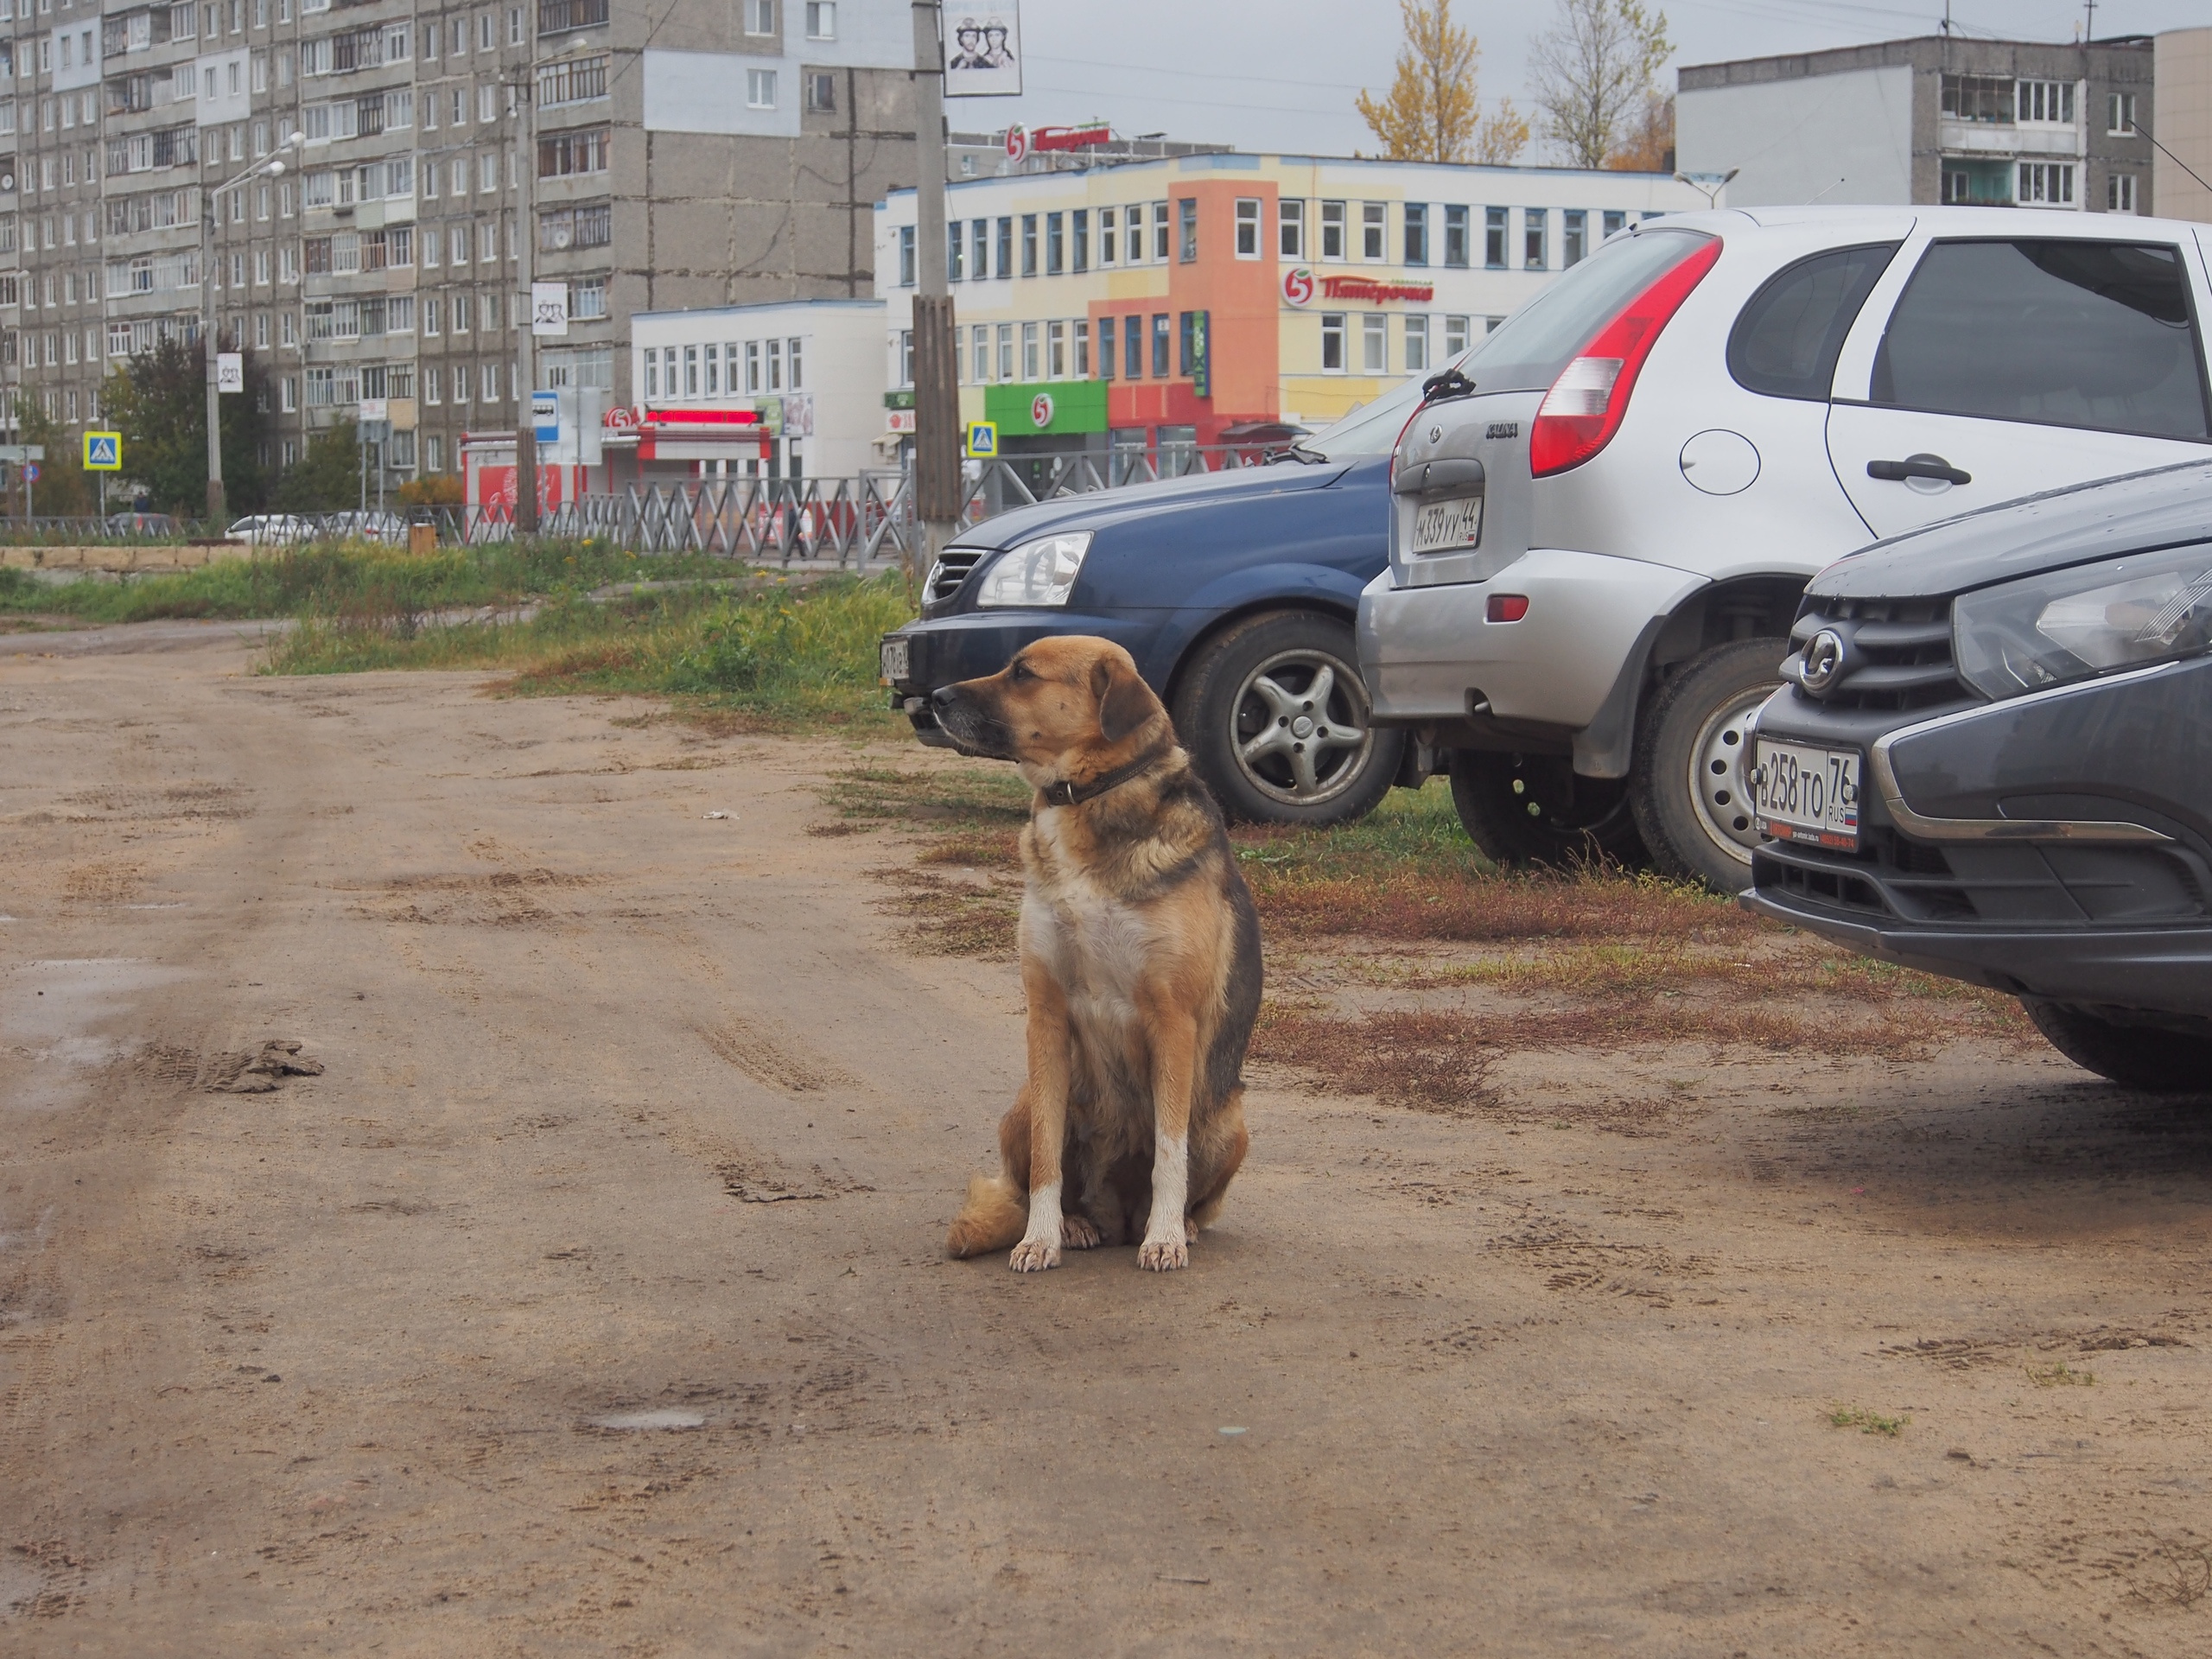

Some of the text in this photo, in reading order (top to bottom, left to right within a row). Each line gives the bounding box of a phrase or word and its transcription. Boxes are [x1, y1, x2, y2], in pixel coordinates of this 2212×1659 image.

[1485, 423, 1518, 439] KALINA
[1462, 501, 1476, 531] 44
[1830, 757, 1851, 805] 76
[1828, 805, 1845, 823] RUS
